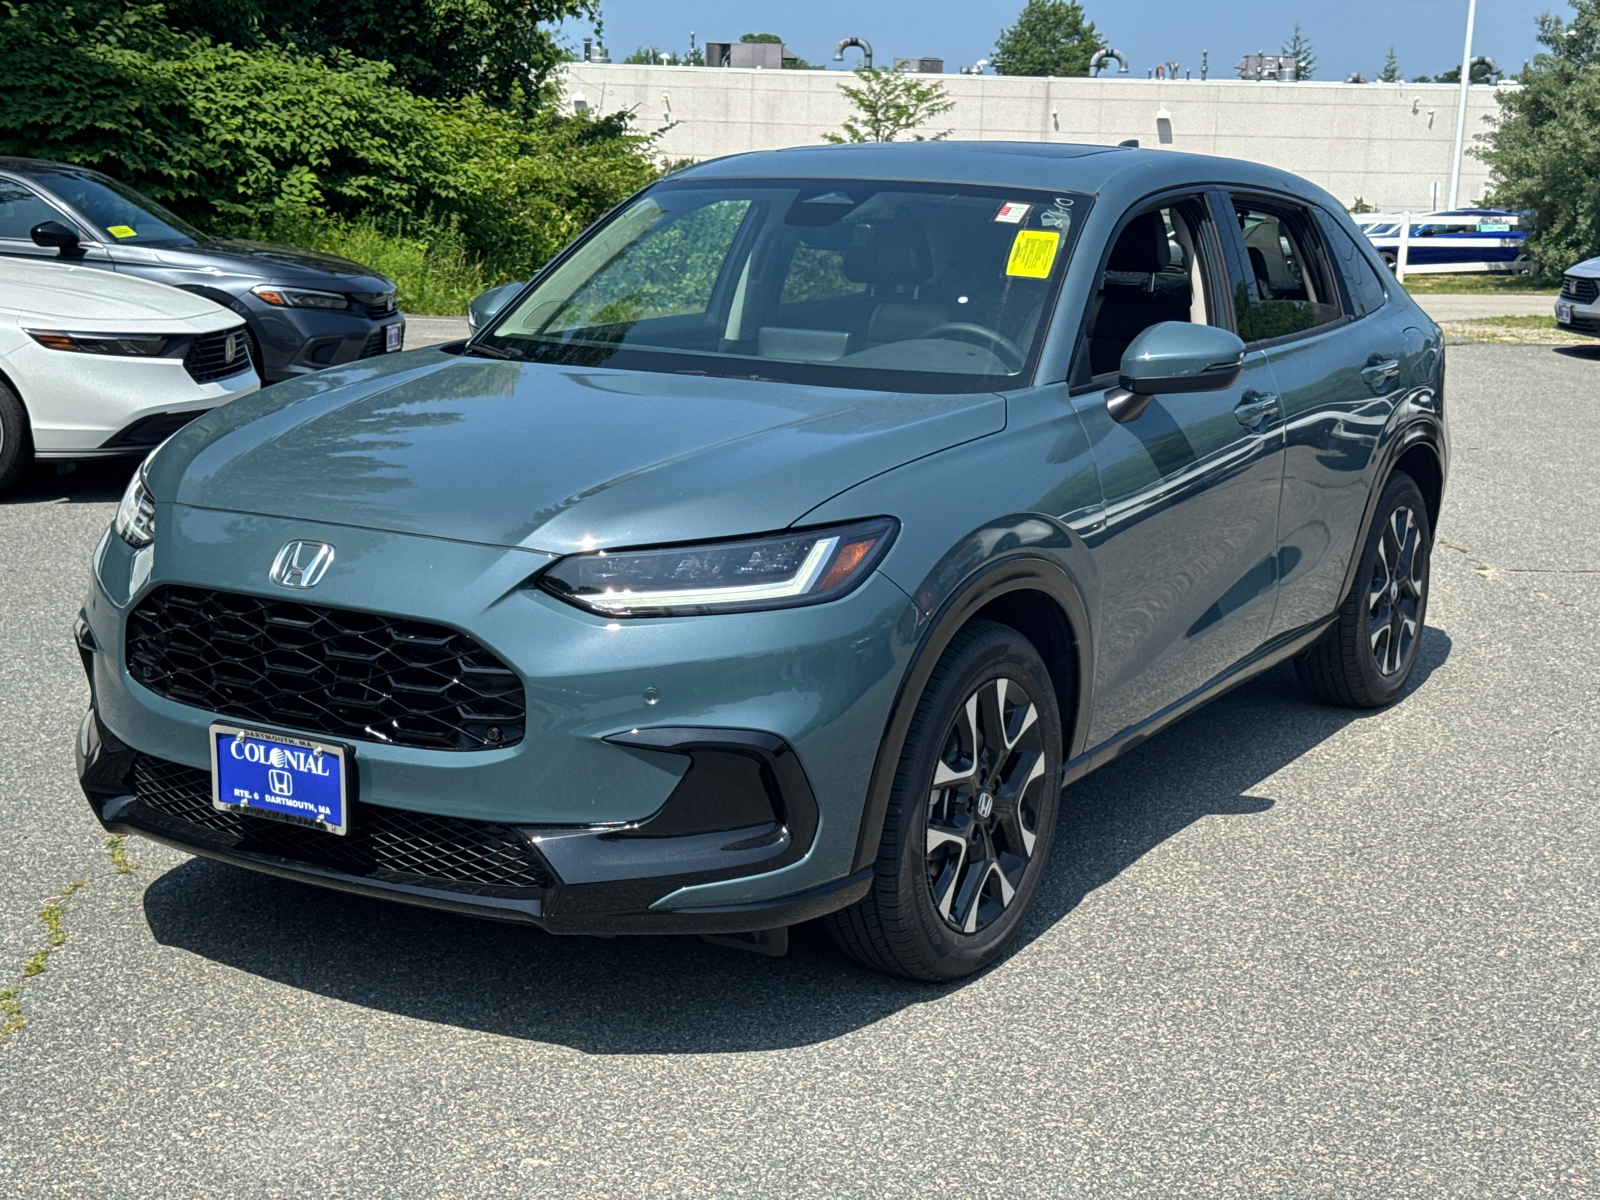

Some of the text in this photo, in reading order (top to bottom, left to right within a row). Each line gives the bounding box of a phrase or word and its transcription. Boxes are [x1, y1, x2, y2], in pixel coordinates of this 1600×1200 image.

[230, 740, 329, 776] COLONIAL
[234, 788, 331, 815] RTE. 6 DARTMOUTH, MA
